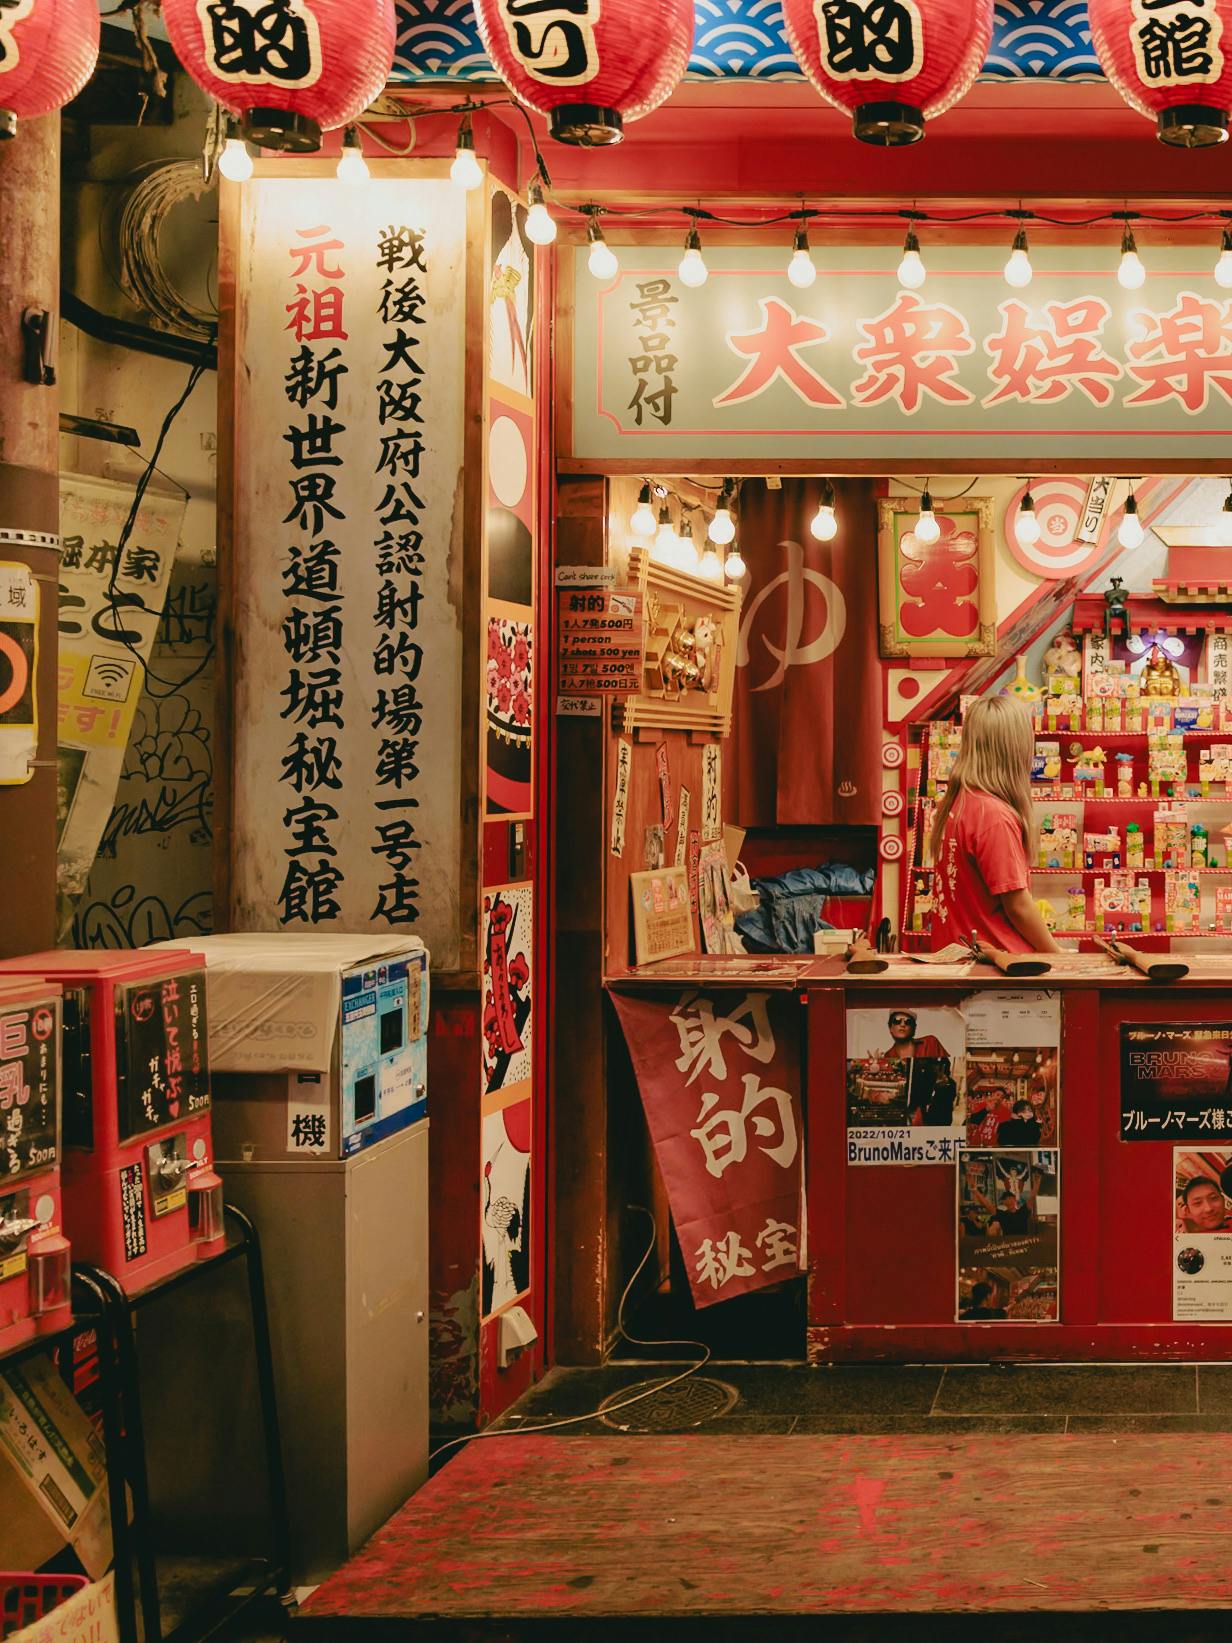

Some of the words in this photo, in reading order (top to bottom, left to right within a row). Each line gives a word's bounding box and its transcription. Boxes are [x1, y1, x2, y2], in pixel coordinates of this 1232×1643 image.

[1138, 0, 1212, 79] 館
[628, 279, 679, 427] 景品付
[369, 226, 428, 926] 戦後大阪府公認射的場第一号店
[0, 585, 27, 609] 域
[568, 594, 605, 613] 射的
[571, 635, 612, 645] person
[600, 648, 620, 657] 500
[621, 649, 641, 660] yen
[1090, 635, 1105, 676] 家内
[1129, 1052, 1215, 1066] BRUNO
[1137, 1065, 1206, 1080] MARS
[669, 991, 798, 1179] 射的
[848, 1130, 912, 1140] 2022/10/21
